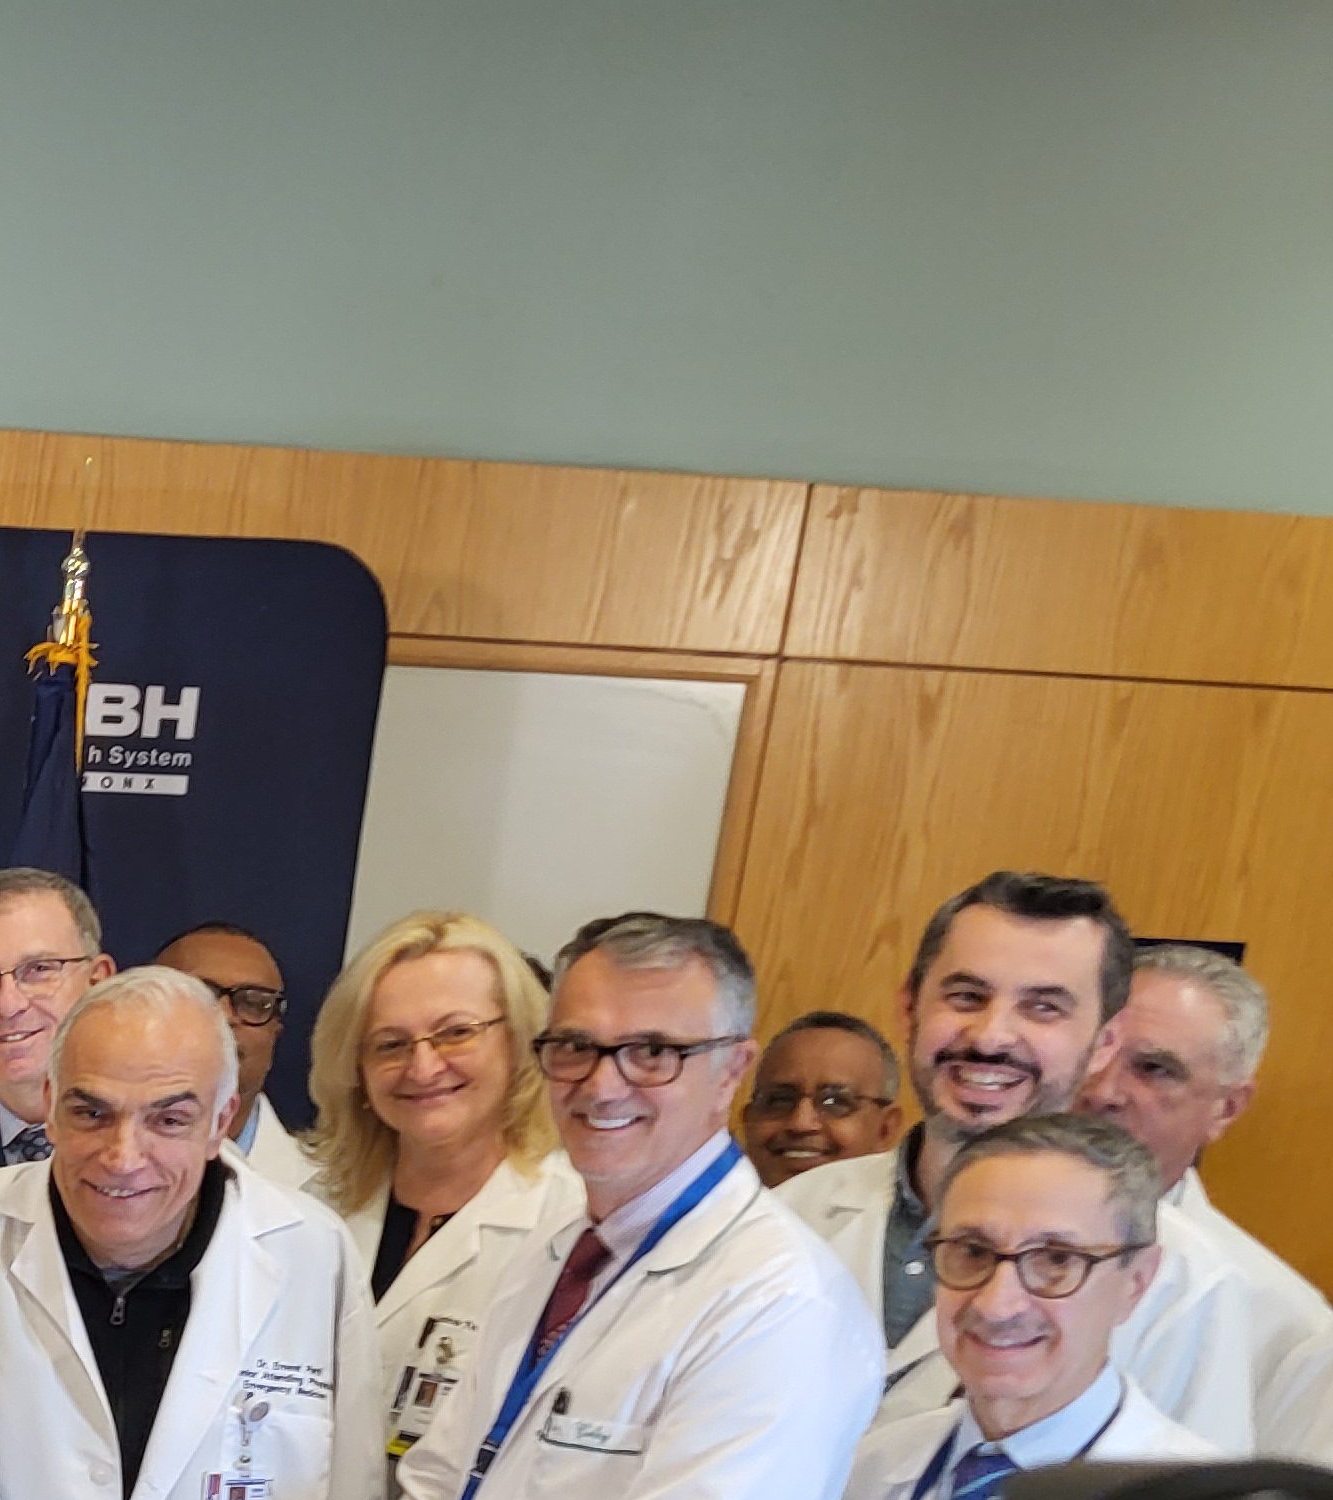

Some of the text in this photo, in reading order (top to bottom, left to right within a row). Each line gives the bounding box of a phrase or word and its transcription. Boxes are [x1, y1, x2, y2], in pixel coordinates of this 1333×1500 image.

[85, 682, 201, 741] BH
[108, 745, 192, 769] System
[81, 775, 157, 790] ONX
